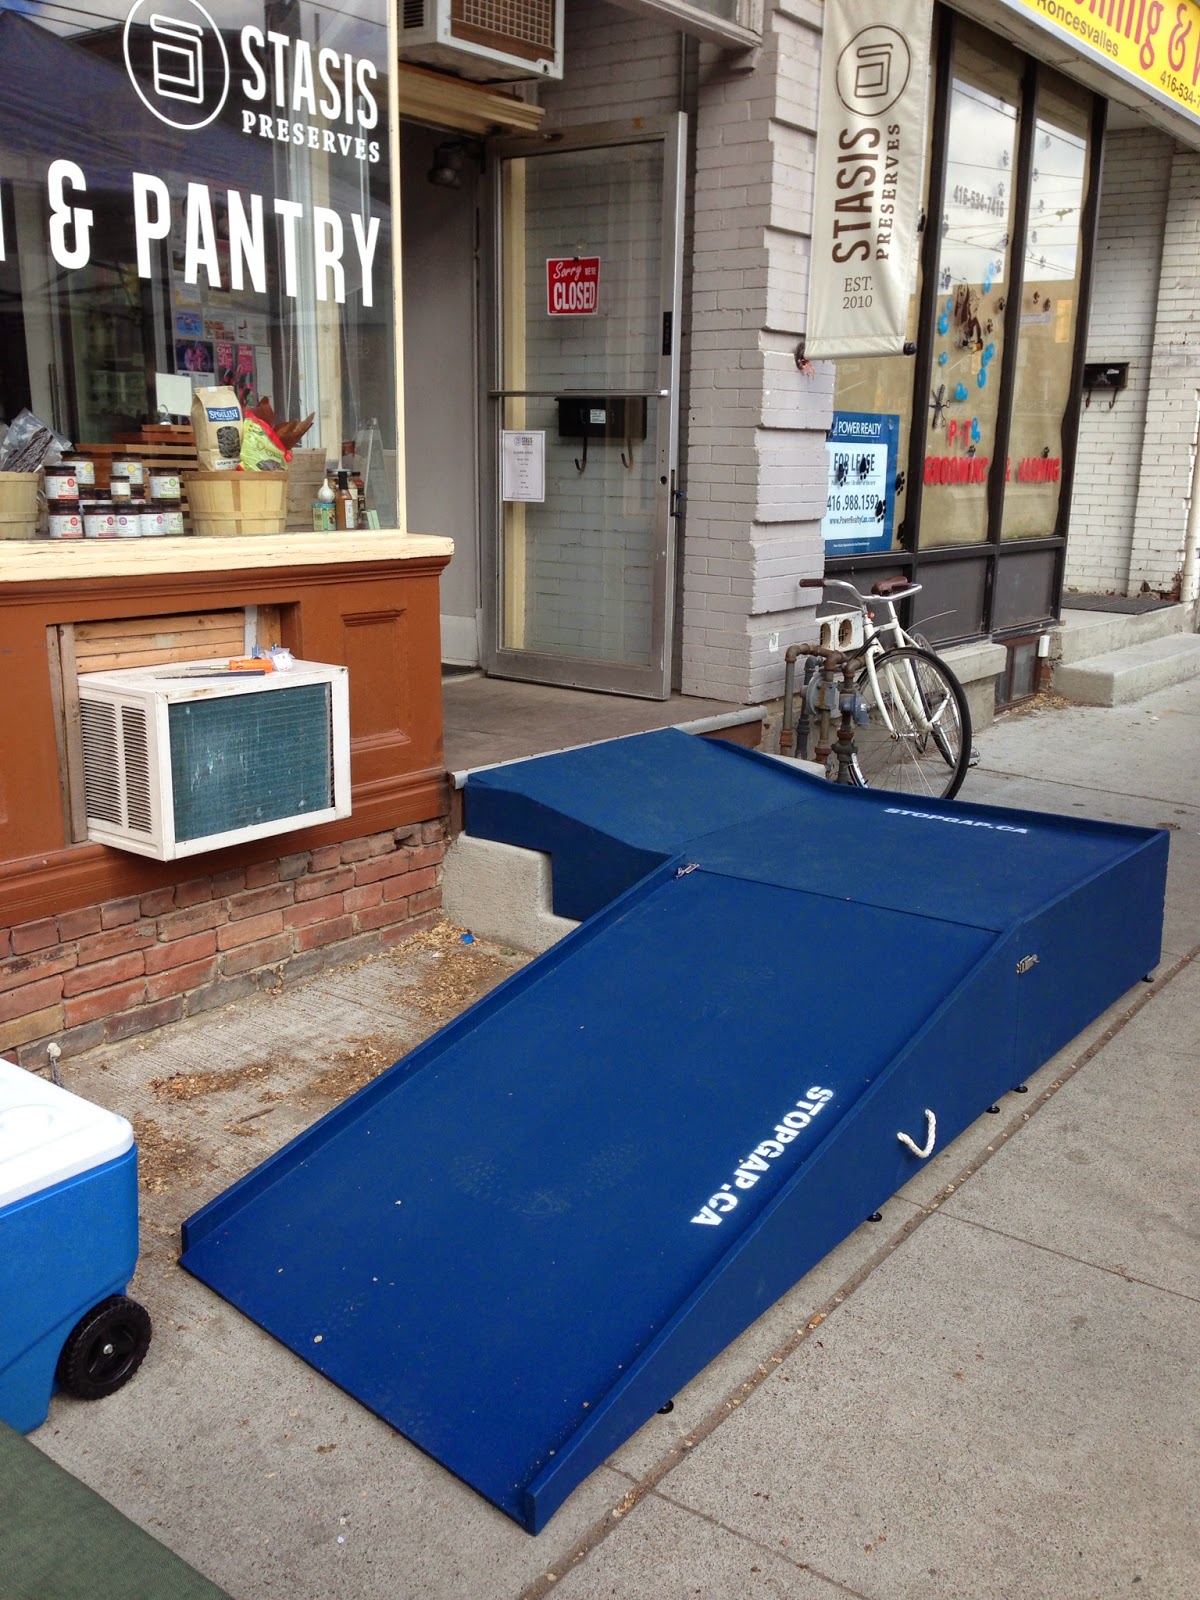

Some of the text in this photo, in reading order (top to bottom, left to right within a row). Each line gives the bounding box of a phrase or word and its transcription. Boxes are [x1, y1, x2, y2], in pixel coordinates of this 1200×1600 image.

[1168, 3, 1193, 72] &
[241, 24, 379, 130] STASIS
[242, 109, 381, 164] PRESERVES
[832, 126, 881, 264] STASIS
[875, 123, 901, 261] PRESERVES
[47, 158, 94, 270] &
[132, 171, 381, 308] PANTRY
[553, 262, 582, 281] Sorry
[553, 281, 597, 311] CLOSED
[844, 276, 874, 293] EST.
[842, 294, 873, 310] 2010
[838, 420, 882, 436] POWER REALTY
[884, 807, 1029, 834] STOPGAP.CA
[690, 1085, 835, 1227] STOPGAP.CA
